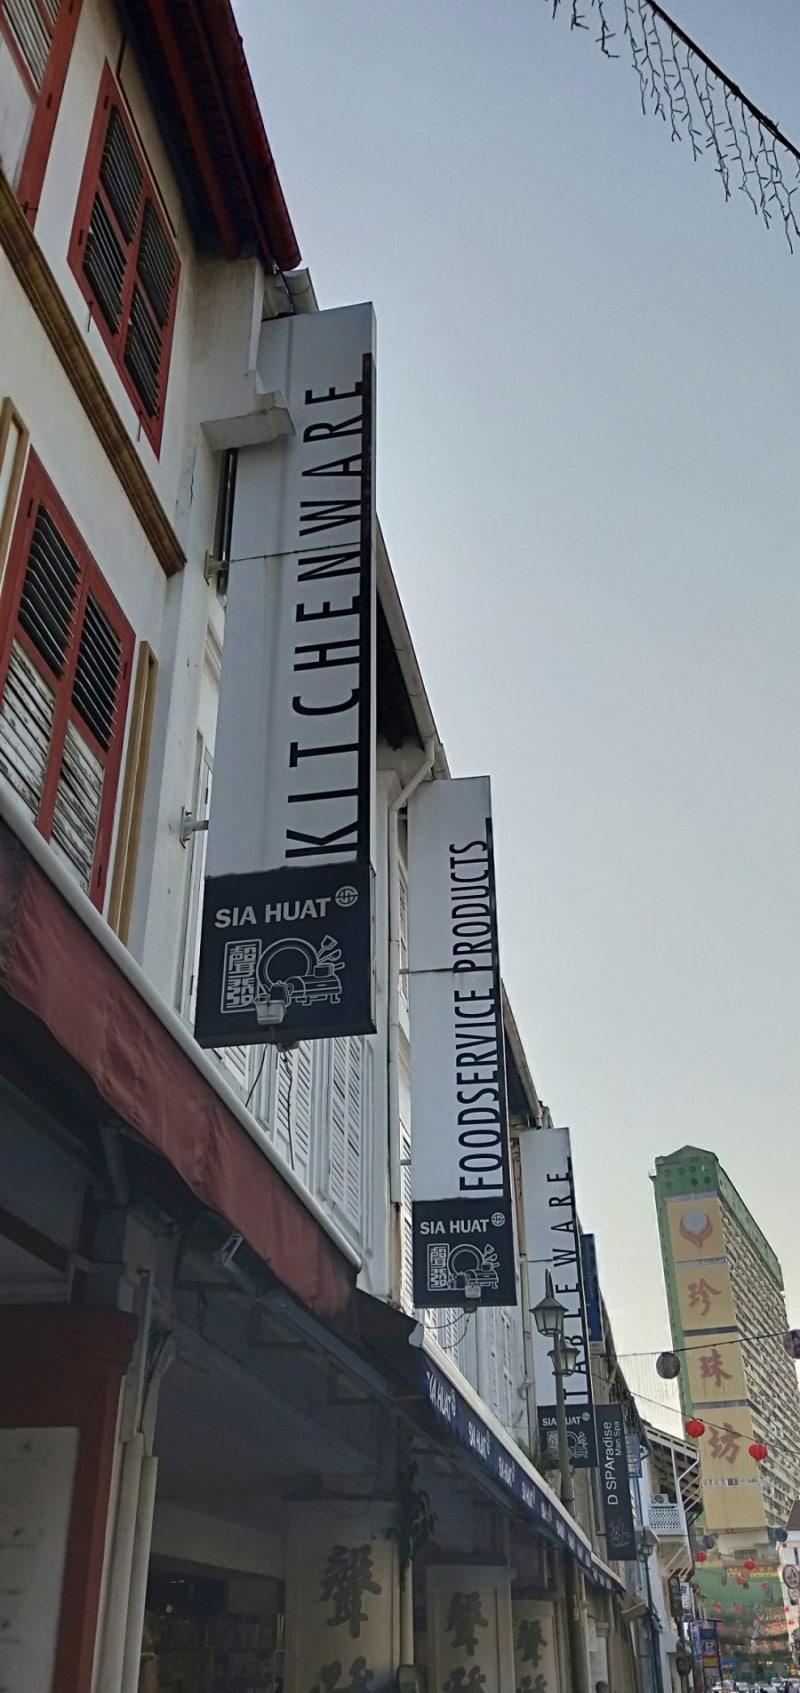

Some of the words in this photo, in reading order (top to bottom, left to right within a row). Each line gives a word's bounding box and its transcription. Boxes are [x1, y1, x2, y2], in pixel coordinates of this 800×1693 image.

[285, 379, 364, 859] KITCHENWARE
[214, 905, 257, 929] SIA
[265, 897, 331, 924] HUAT
[450, 839, 494, 974] PRODUCTS
[454, 987, 504, 1192] FOODSERVICE
[419, 1221, 446, 1235] SIA
[449, 1218, 489, 1234] HUAT
[542, 1417, 557, 1427] SIA
[564, 1416, 581, 1425] UAT
[613, 1421, 621, 1437] Spa
[602, 1421, 617, 1490] SPAradise
[608, 1494, 619, 1505] D
